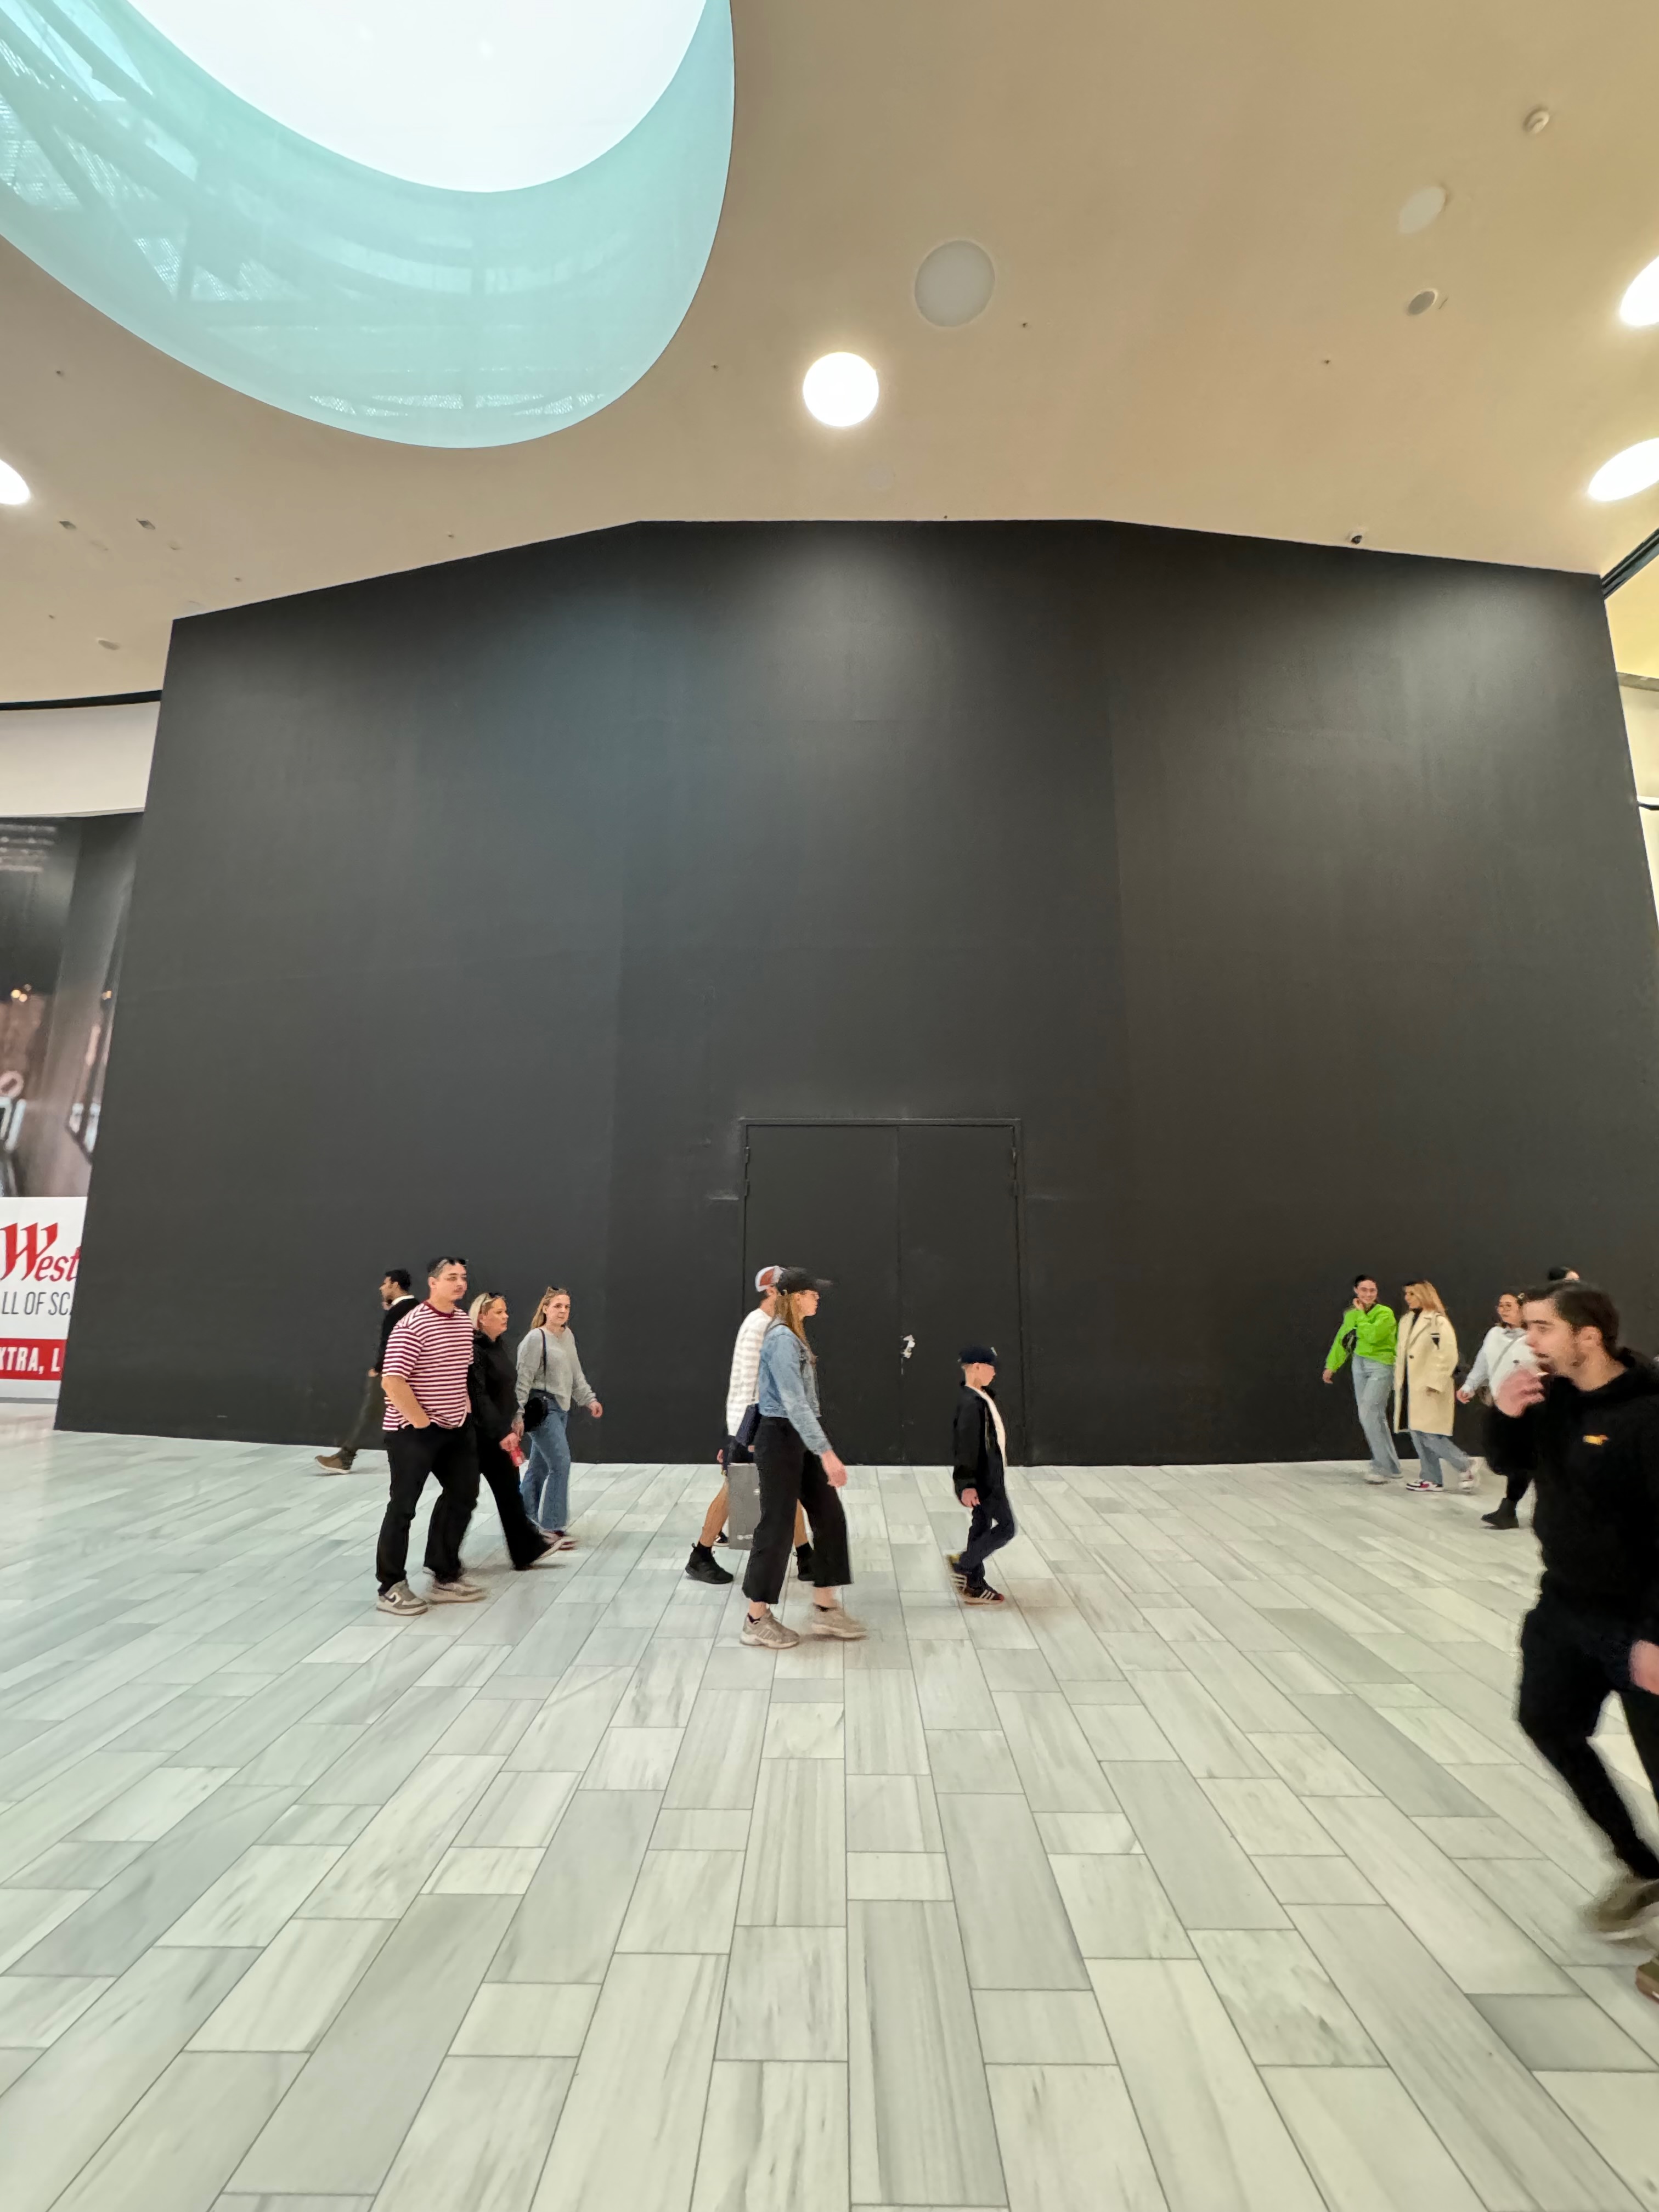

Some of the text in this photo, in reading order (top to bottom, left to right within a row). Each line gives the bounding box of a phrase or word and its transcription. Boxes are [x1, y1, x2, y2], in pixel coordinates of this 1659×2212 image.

[2, 1291, 71, 1316] LL OF SC
